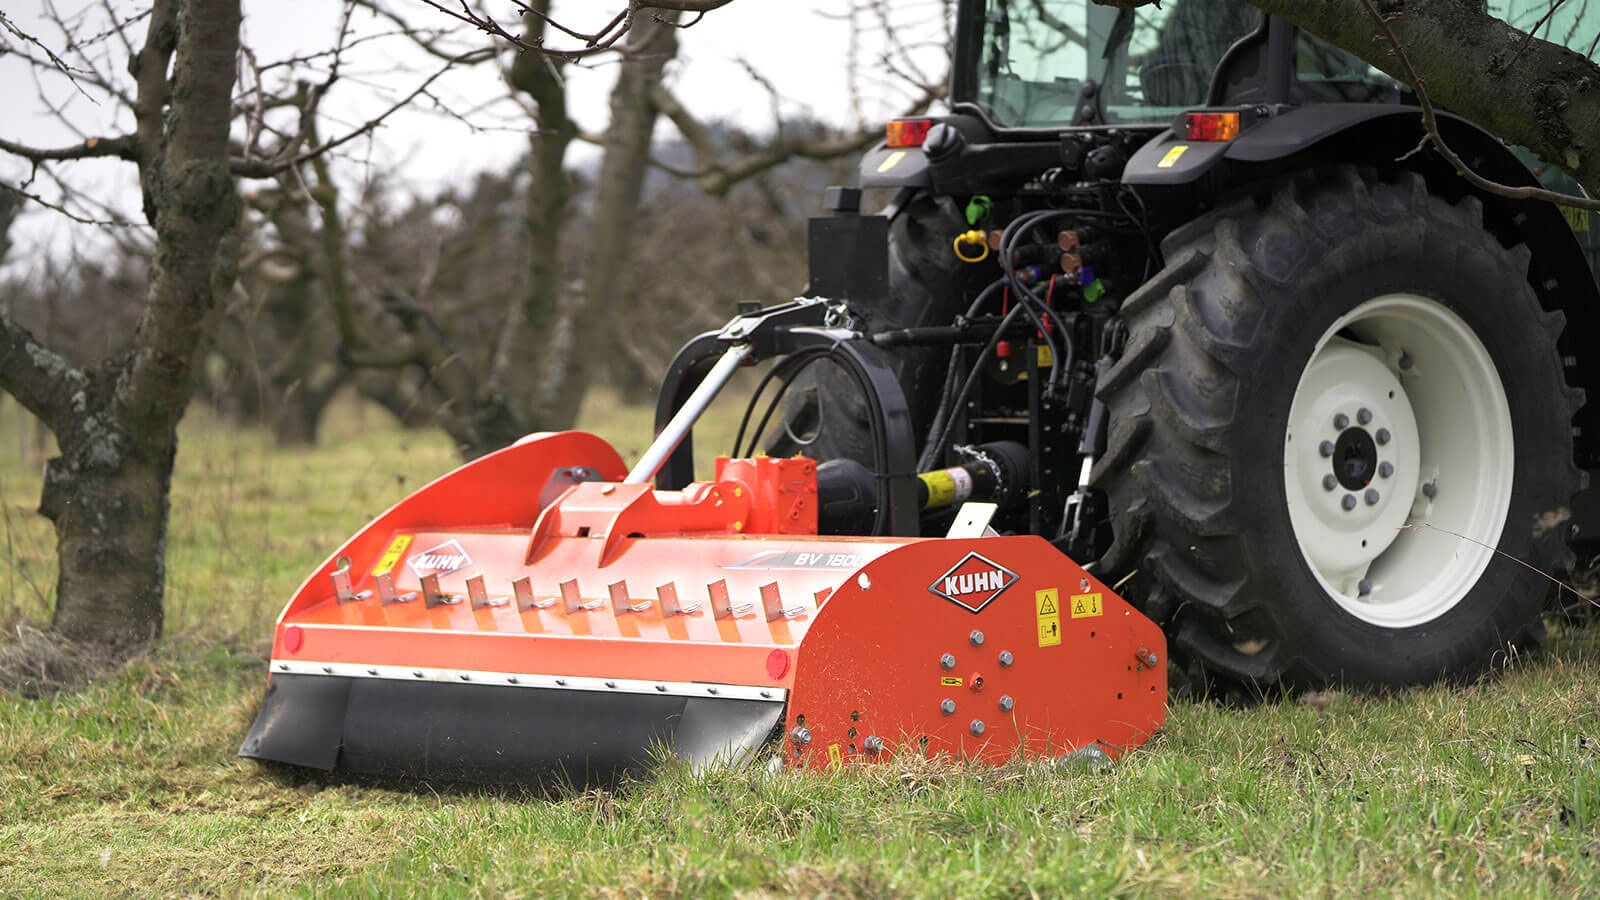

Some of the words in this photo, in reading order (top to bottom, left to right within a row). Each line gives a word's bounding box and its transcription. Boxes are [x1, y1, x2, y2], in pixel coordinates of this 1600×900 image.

[415, 554, 464, 570] KUHN
[793, 553, 823, 566] BV
[945, 570, 1004, 596] KUHN
